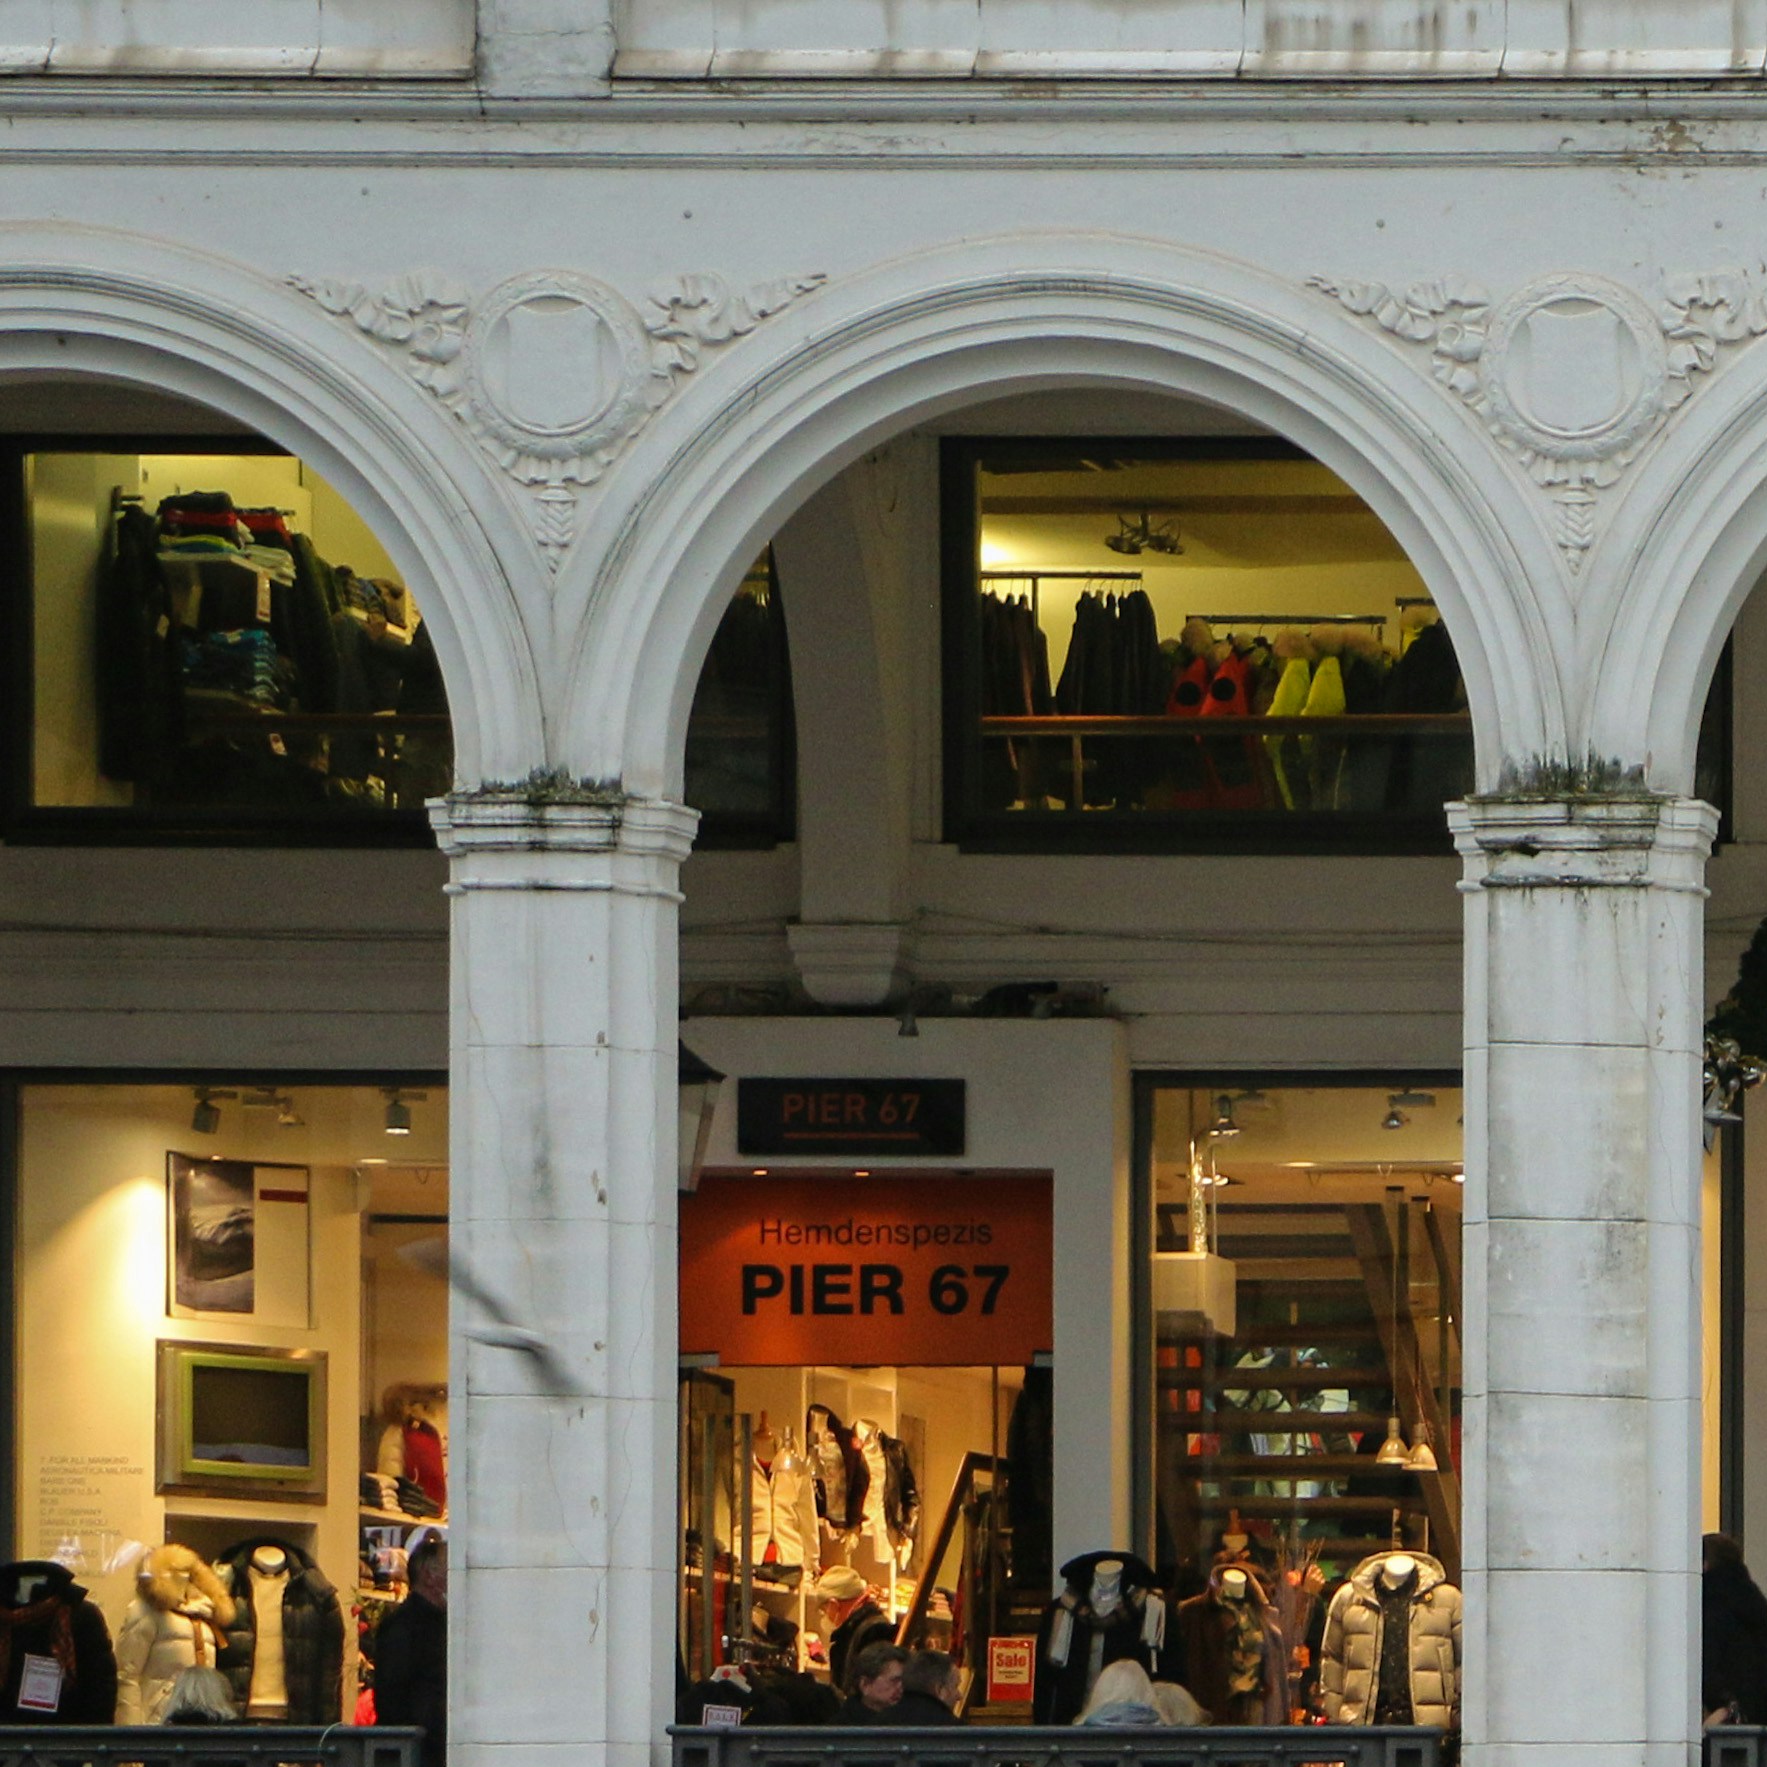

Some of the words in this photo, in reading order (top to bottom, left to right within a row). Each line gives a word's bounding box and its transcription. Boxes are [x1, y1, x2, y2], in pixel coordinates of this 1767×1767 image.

[783, 1095, 864, 1123] PIER
[879, 1094, 920, 1123] 67
[760, 1218, 993, 1251] Hemdenspezis
[742, 1266, 905, 1315] PIER
[928, 1265, 1011, 1315] 67
[996, 1652, 1027, 1668] Sale
